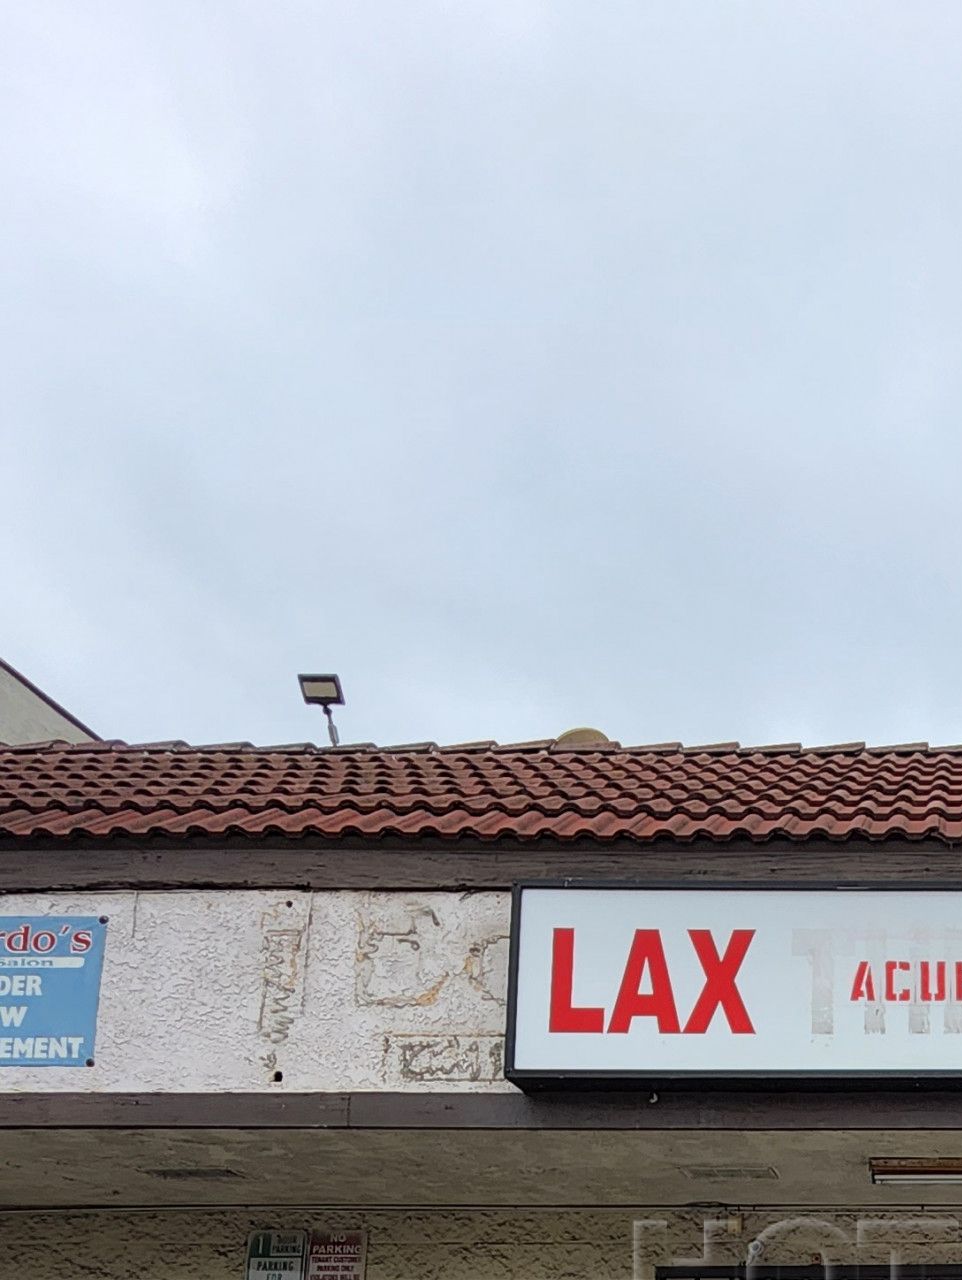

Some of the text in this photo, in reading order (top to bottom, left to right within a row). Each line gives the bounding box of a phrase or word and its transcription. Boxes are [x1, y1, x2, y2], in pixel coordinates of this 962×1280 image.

[549, 928, 756, 1034] LAX
[0, 1037, 84, 1058] EMENT
[330, 1231, 347, 1242] NO
[312, 1244, 362, 1254] PARKING
[256, 1260, 294, 1272] PARKING
